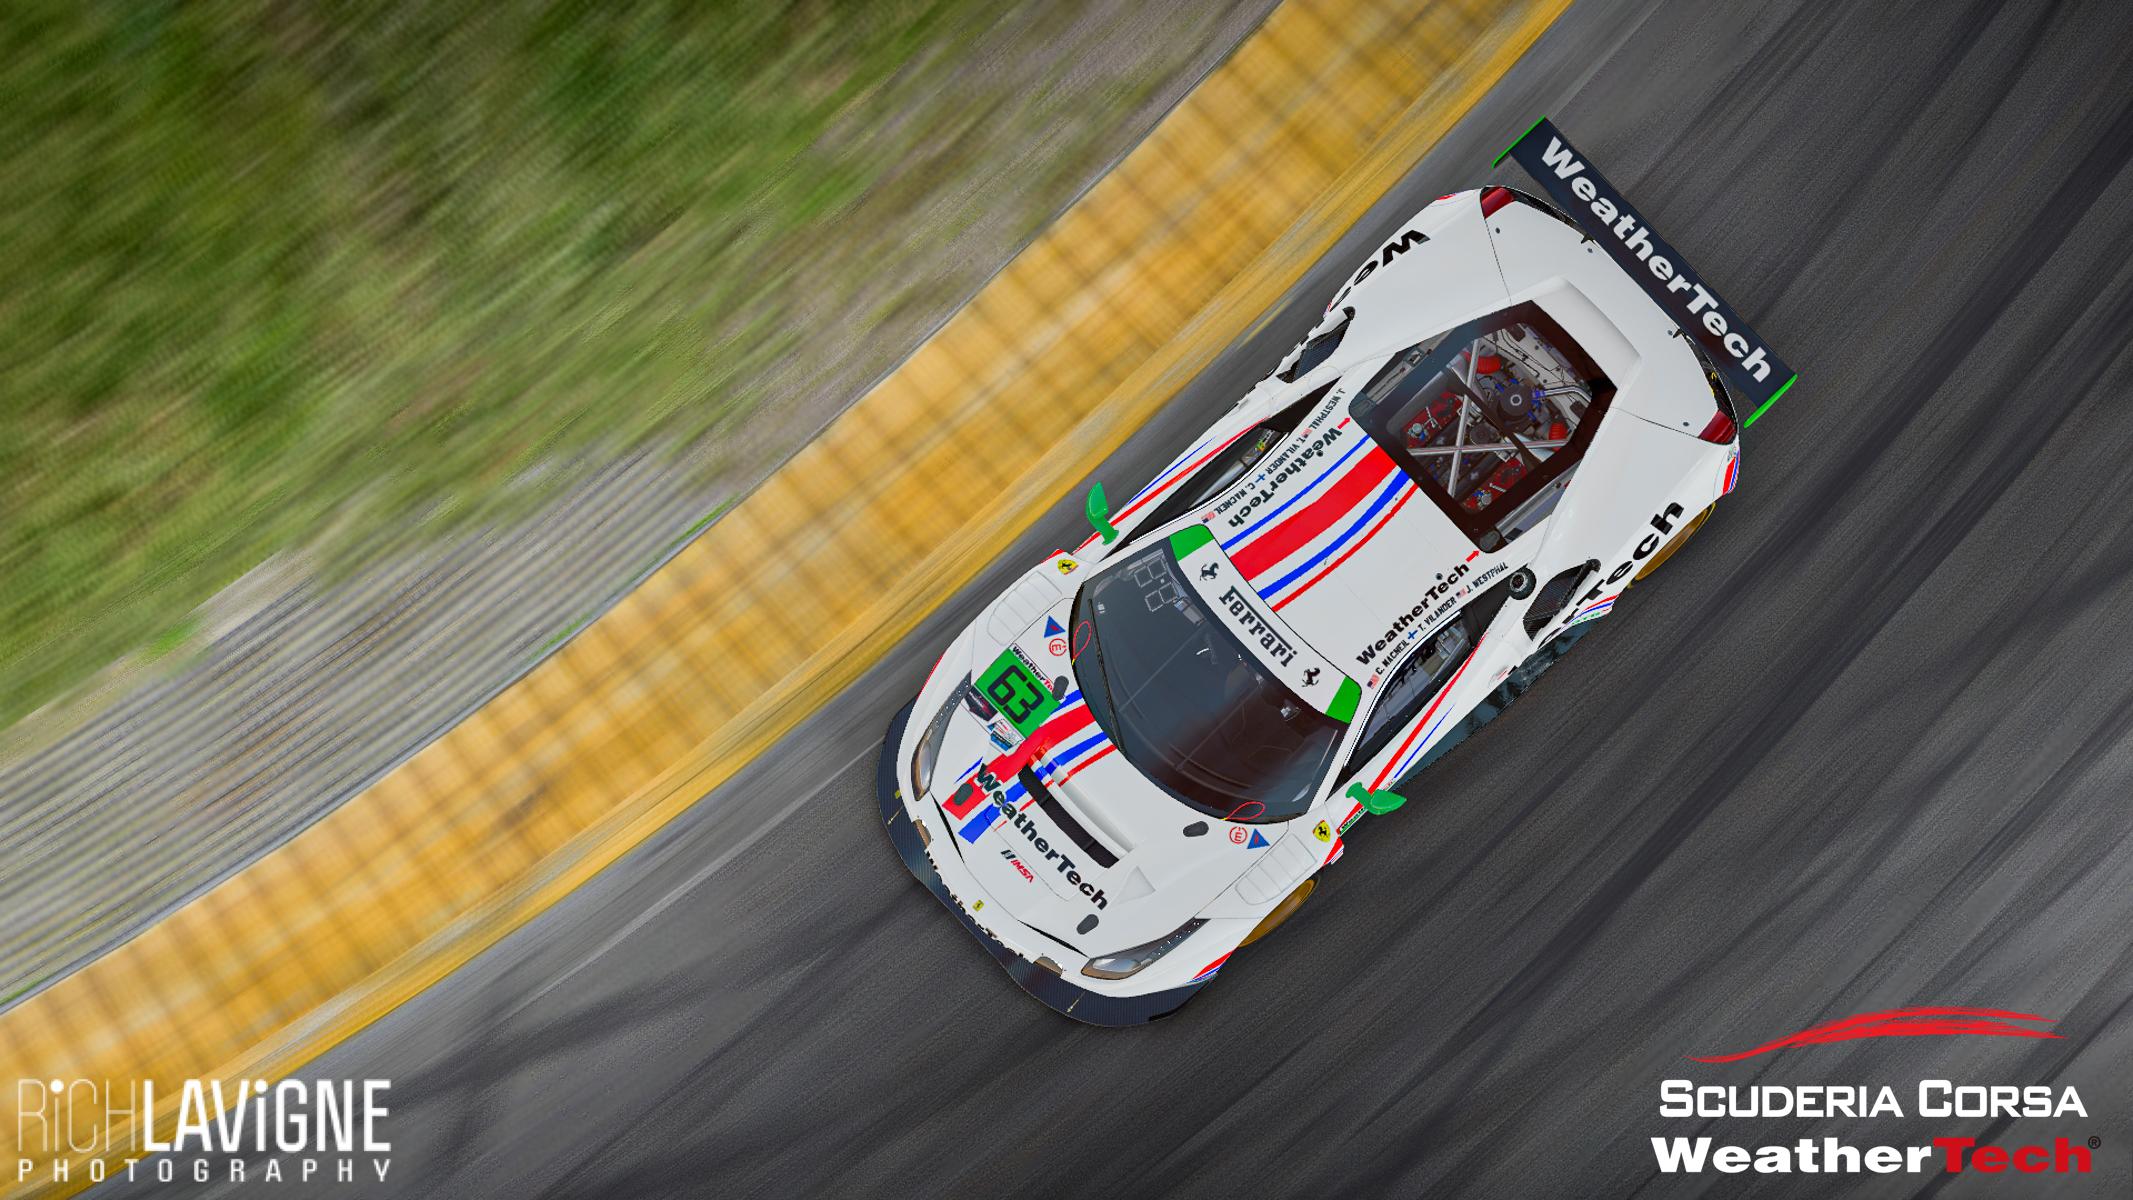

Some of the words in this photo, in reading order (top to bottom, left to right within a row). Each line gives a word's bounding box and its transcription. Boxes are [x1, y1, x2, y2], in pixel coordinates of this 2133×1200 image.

[1542, 136, 1772, 383] WeatherTech
[1312, 395, 1342, 430] WESTPHAL
[1228, 427, 1343, 528] WeatherTech
[1265, 444, 1300, 475] VILANDER
[1214, 488, 1248, 516] MACNEIL
[1219, 585, 1298, 667] Ferrari
[1356, 563, 1470, 665] WeatherTech
[1382, 639, 1410, 667] MACNEIL
[1424, 596, 1457, 626] VILANDER
[1472, 562, 1508, 588] WESTPHAL
[987, 665, 1045, 724] 63
[976, 763, 1108, 910] WeatherTech
[1010, 859, 1035, 883] IMSA
